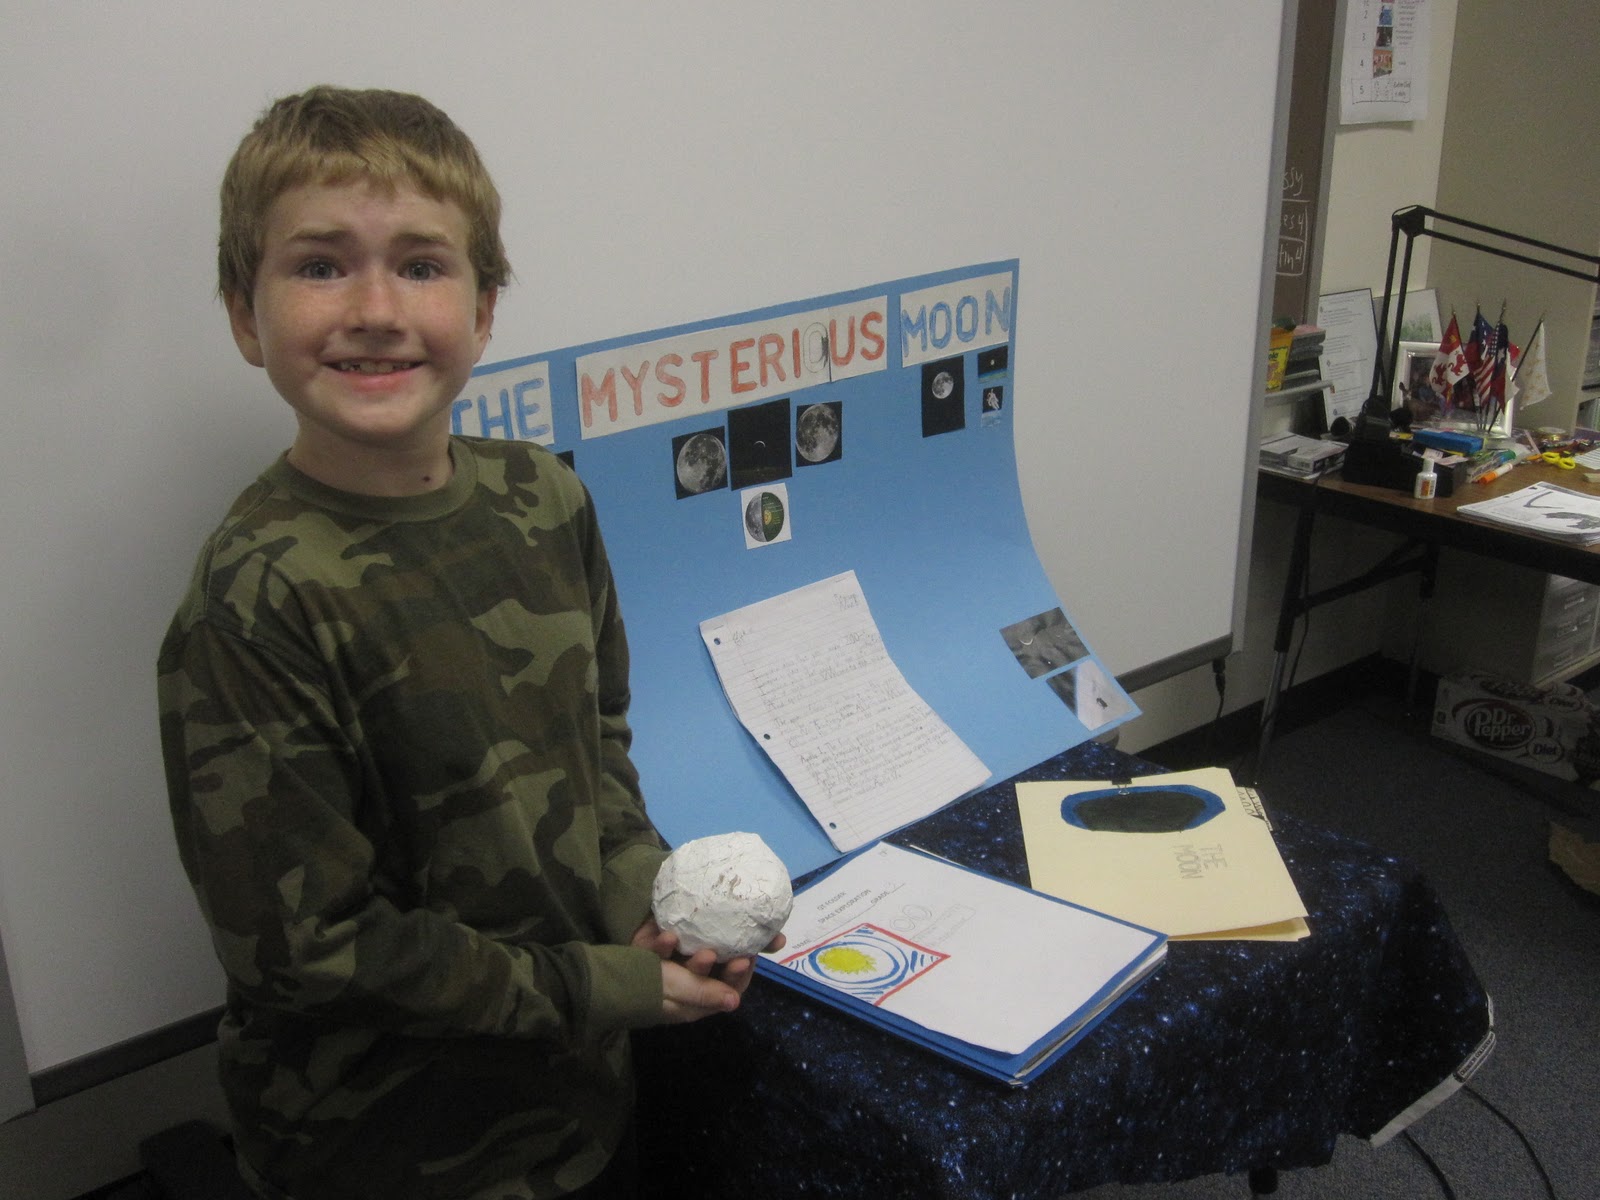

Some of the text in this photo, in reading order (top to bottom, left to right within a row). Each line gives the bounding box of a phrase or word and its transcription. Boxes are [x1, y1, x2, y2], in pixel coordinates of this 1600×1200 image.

[581, 311, 885, 428] MYSTERIOUS
[901, 286, 1011, 358] MOON
[1474, 708, 1531, 741] Pepper
[1492, 707, 1516, 724] Dr
[1533, 743, 1557, 756] Diet
